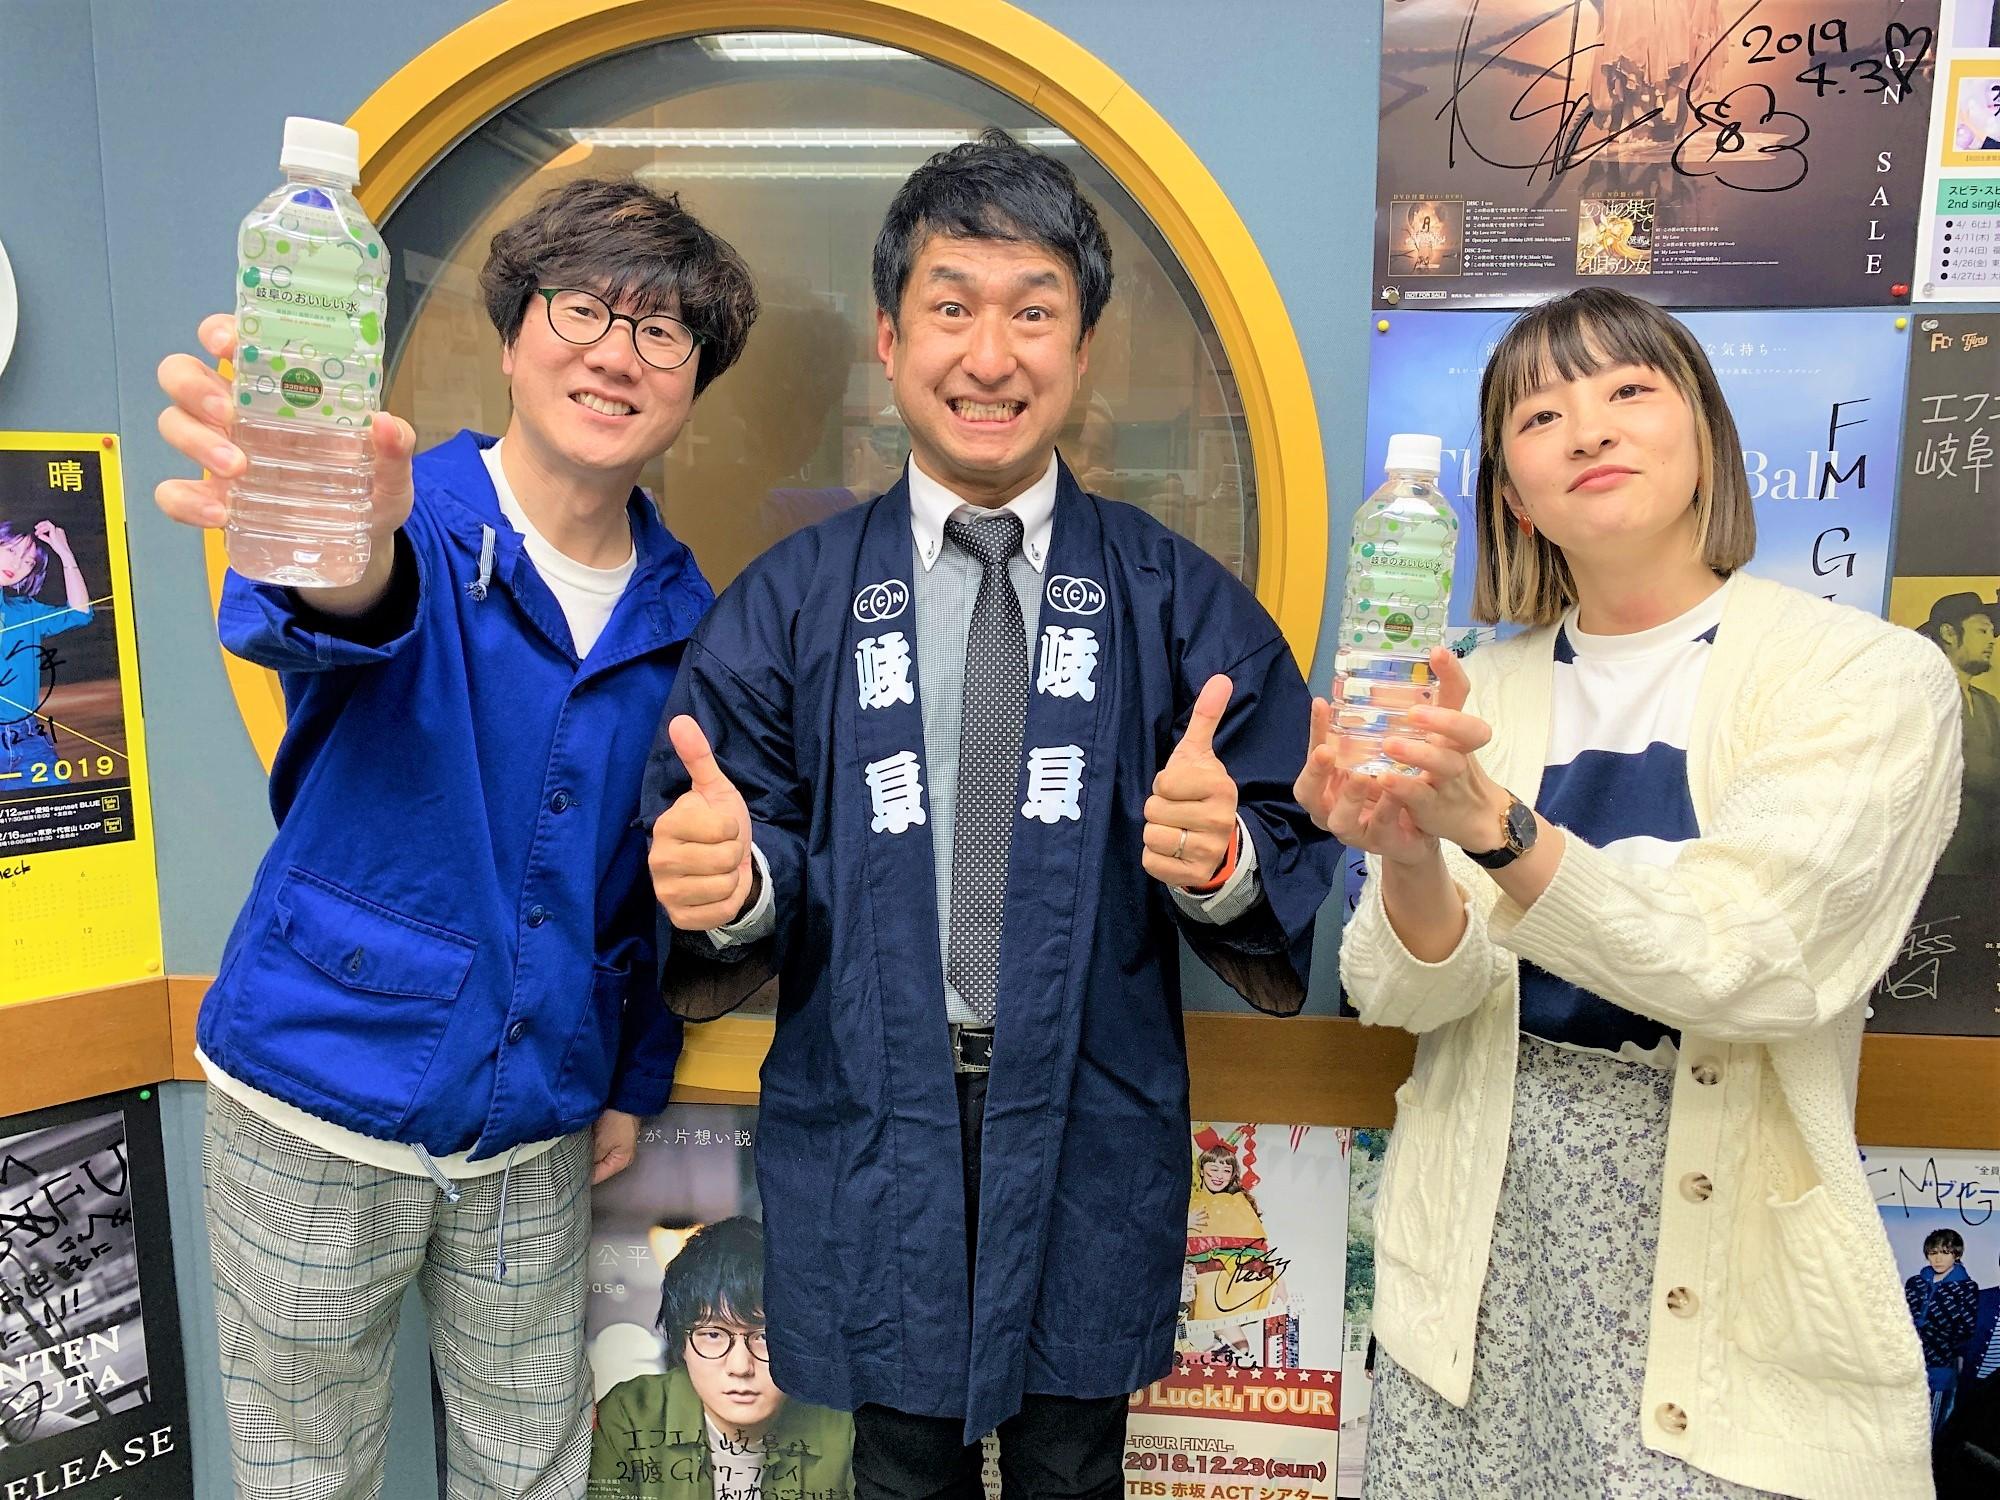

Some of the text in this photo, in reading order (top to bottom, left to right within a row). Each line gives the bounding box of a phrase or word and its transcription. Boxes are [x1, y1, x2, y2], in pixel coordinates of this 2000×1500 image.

[1742, 19, 1848, 64] 2019
[1864, 151, 1892, 275] SALE
[1947, 199, 1969, 209] 2nd
[256, 287, 358, 312] 岐阜のおいしい水
[1915, 427, 1993, 493] 岐阜
[48, 461, 84, 492] 晴
[637, 1128, 752, 1146] が、片想い説
[597, 1243, 650, 1269] 公平
[1124, 1451, 1328, 1482] 2018.12.23(sun)
[1126, 1481, 1167, 1496] TBS
[1171, 1482, 1206, 1499] 赤坂
[1210, 1485, 1255, 1500] ACT
